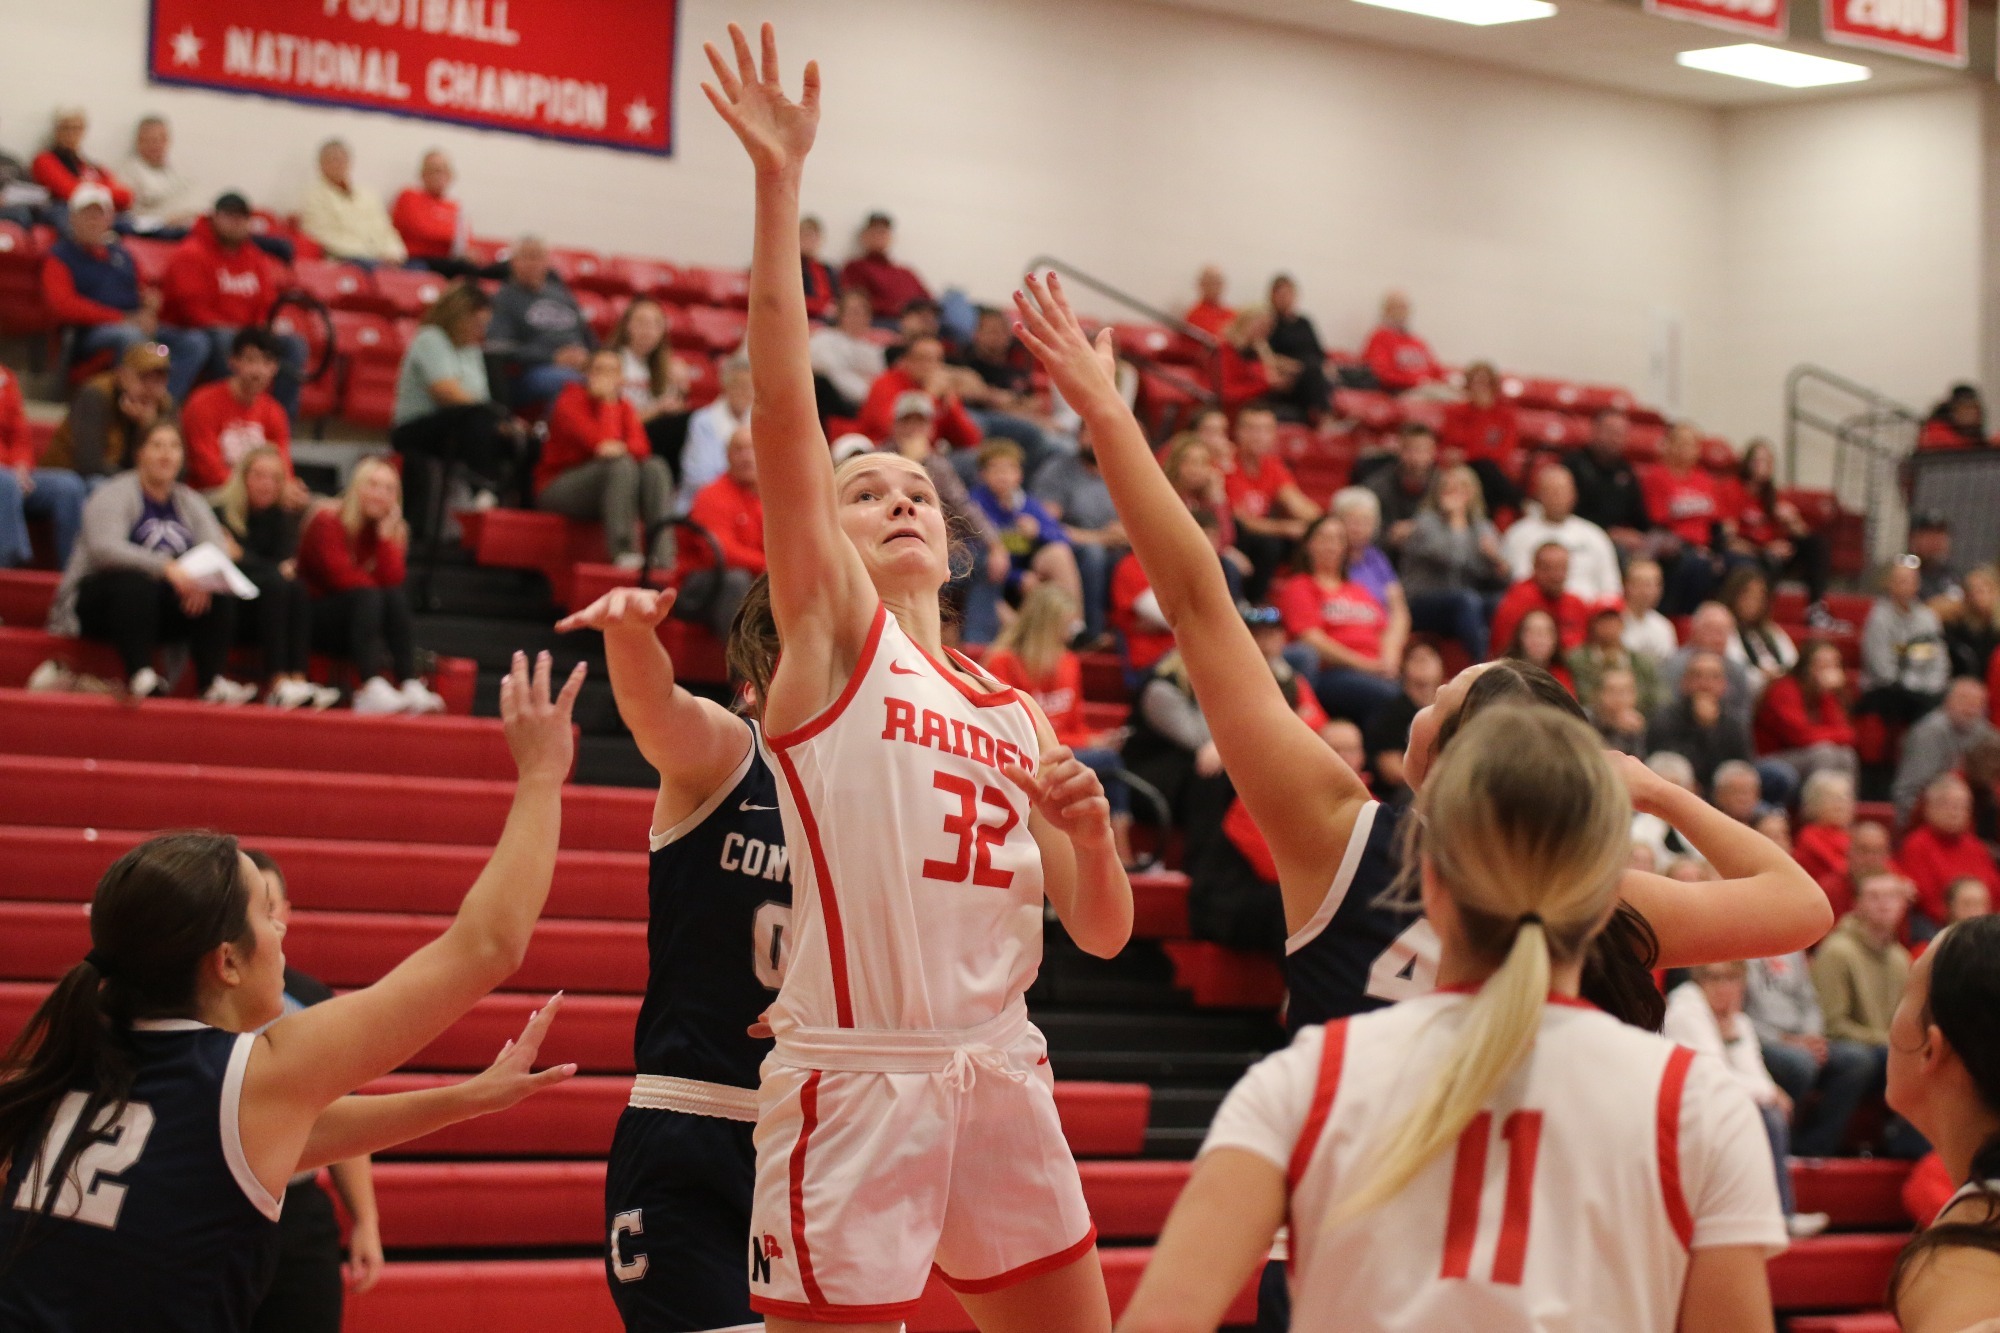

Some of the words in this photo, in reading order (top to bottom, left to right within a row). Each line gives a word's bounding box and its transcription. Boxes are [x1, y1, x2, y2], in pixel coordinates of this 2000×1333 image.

[223, 25, 411, 98] NATIONAL
[425, 57, 607, 130] CHAMPION
[720, 832, 793, 886] CON
[922, 770, 1020, 889] 32
[12, 1090, 157, 1231] 12
[1439, 1108, 1544, 1287] 11
[611, 1208, 649, 1284] C
